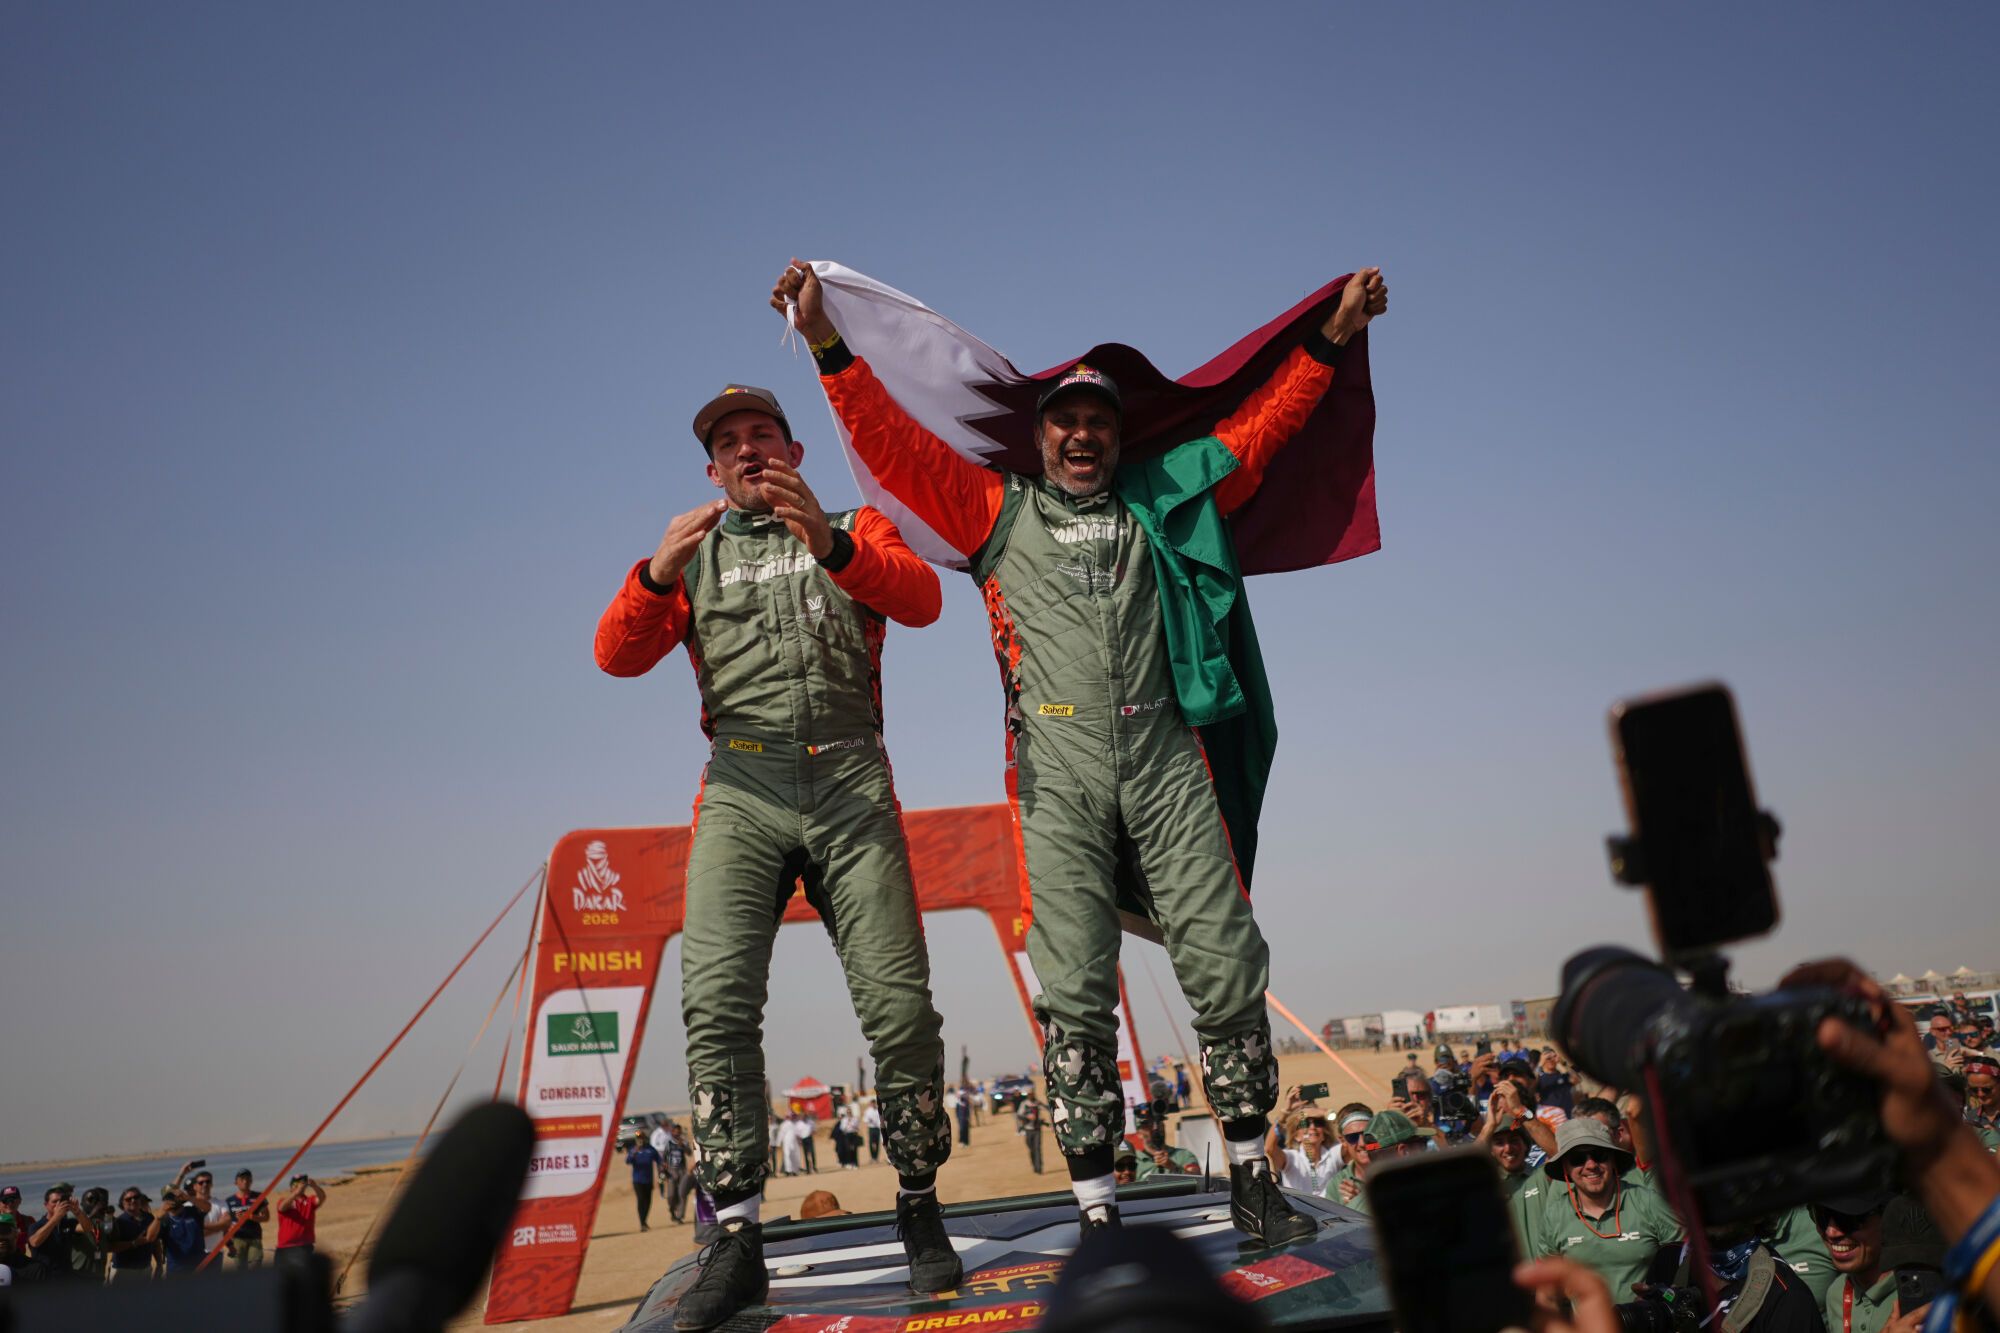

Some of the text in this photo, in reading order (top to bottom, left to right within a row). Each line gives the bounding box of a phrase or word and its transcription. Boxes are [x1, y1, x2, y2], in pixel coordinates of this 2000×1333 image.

[1042, 705, 1070, 716] Sabelt
[732, 740, 759, 752] Sabelt
[572, 887, 627, 912] DAKAR
[582, 912, 619, 925] 2026
[553, 950, 643, 973] FINISH
[550, 1041, 616, 1053] SAUDI ARABIA
[540, 1086, 606, 1101] CONGRATS!
[530, 1154, 590, 1172] STAGE 13
[905, 1308, 1015, 1333] DREAM.
